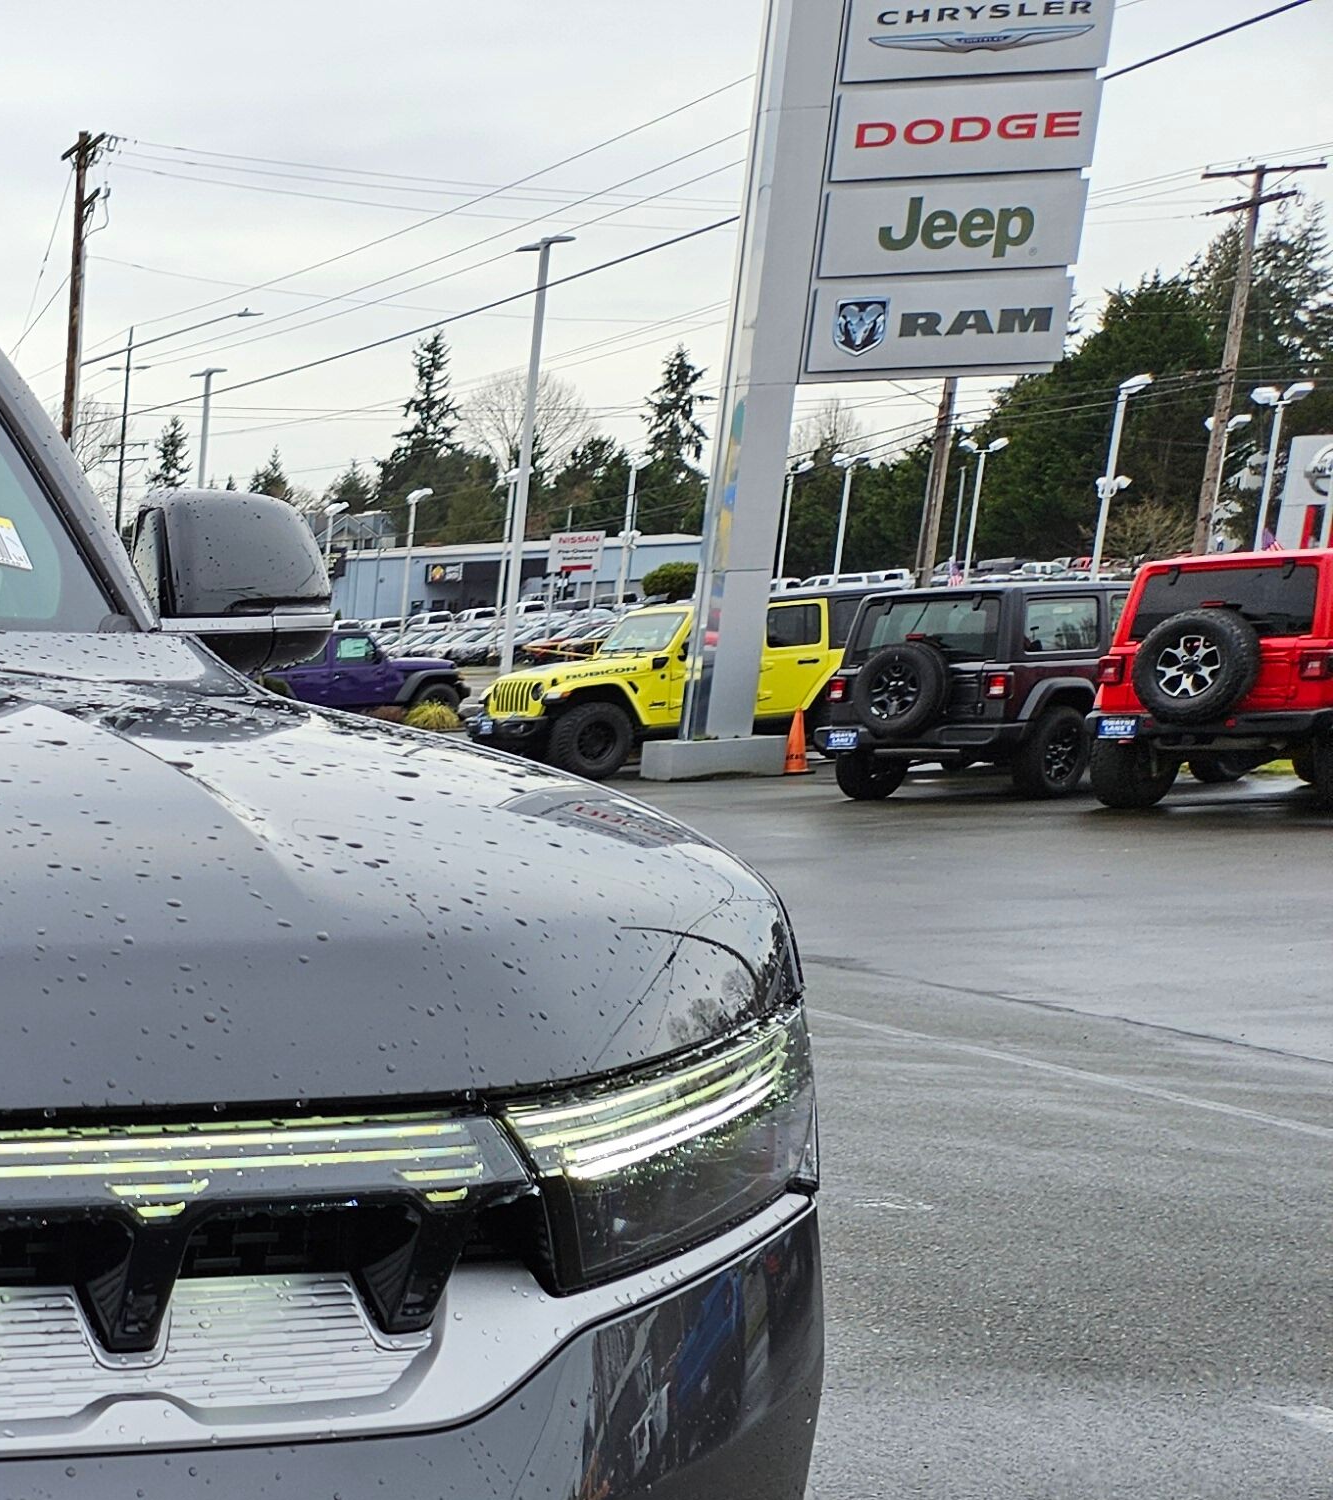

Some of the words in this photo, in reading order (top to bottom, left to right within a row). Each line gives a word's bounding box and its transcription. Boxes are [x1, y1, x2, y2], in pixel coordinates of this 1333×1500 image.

[876, 0, 1092, 26] CHRYSLER
[854, 111, 1084, 150] DODGE
[878, 196, 1035, 259] Jeep
[897, 306, 1054, 339] RAM
[558, 535, 601, 544] NISSAN
[565, 666, 638, 680] RUBICON
